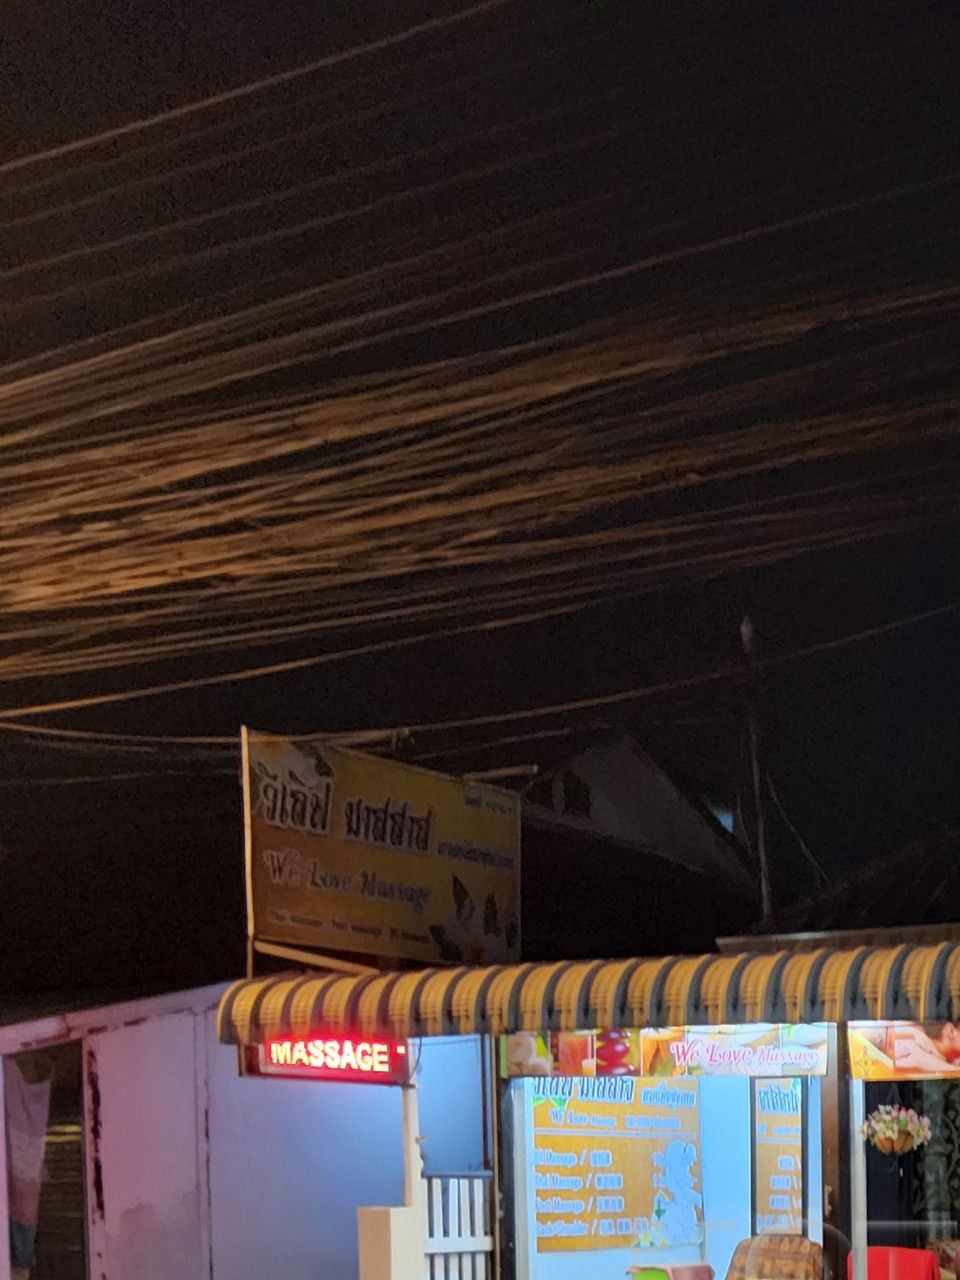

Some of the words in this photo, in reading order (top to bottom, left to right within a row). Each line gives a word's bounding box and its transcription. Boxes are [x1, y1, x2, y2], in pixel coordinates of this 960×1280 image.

[310, 861, 350, 891] Love
[270, 1039, 390, 1073] MASSAGE
[670, 1039, 701, 1065] We
[706, 1041, 751, 1065] Love
[757, 1046, 819, 1068] Massage
